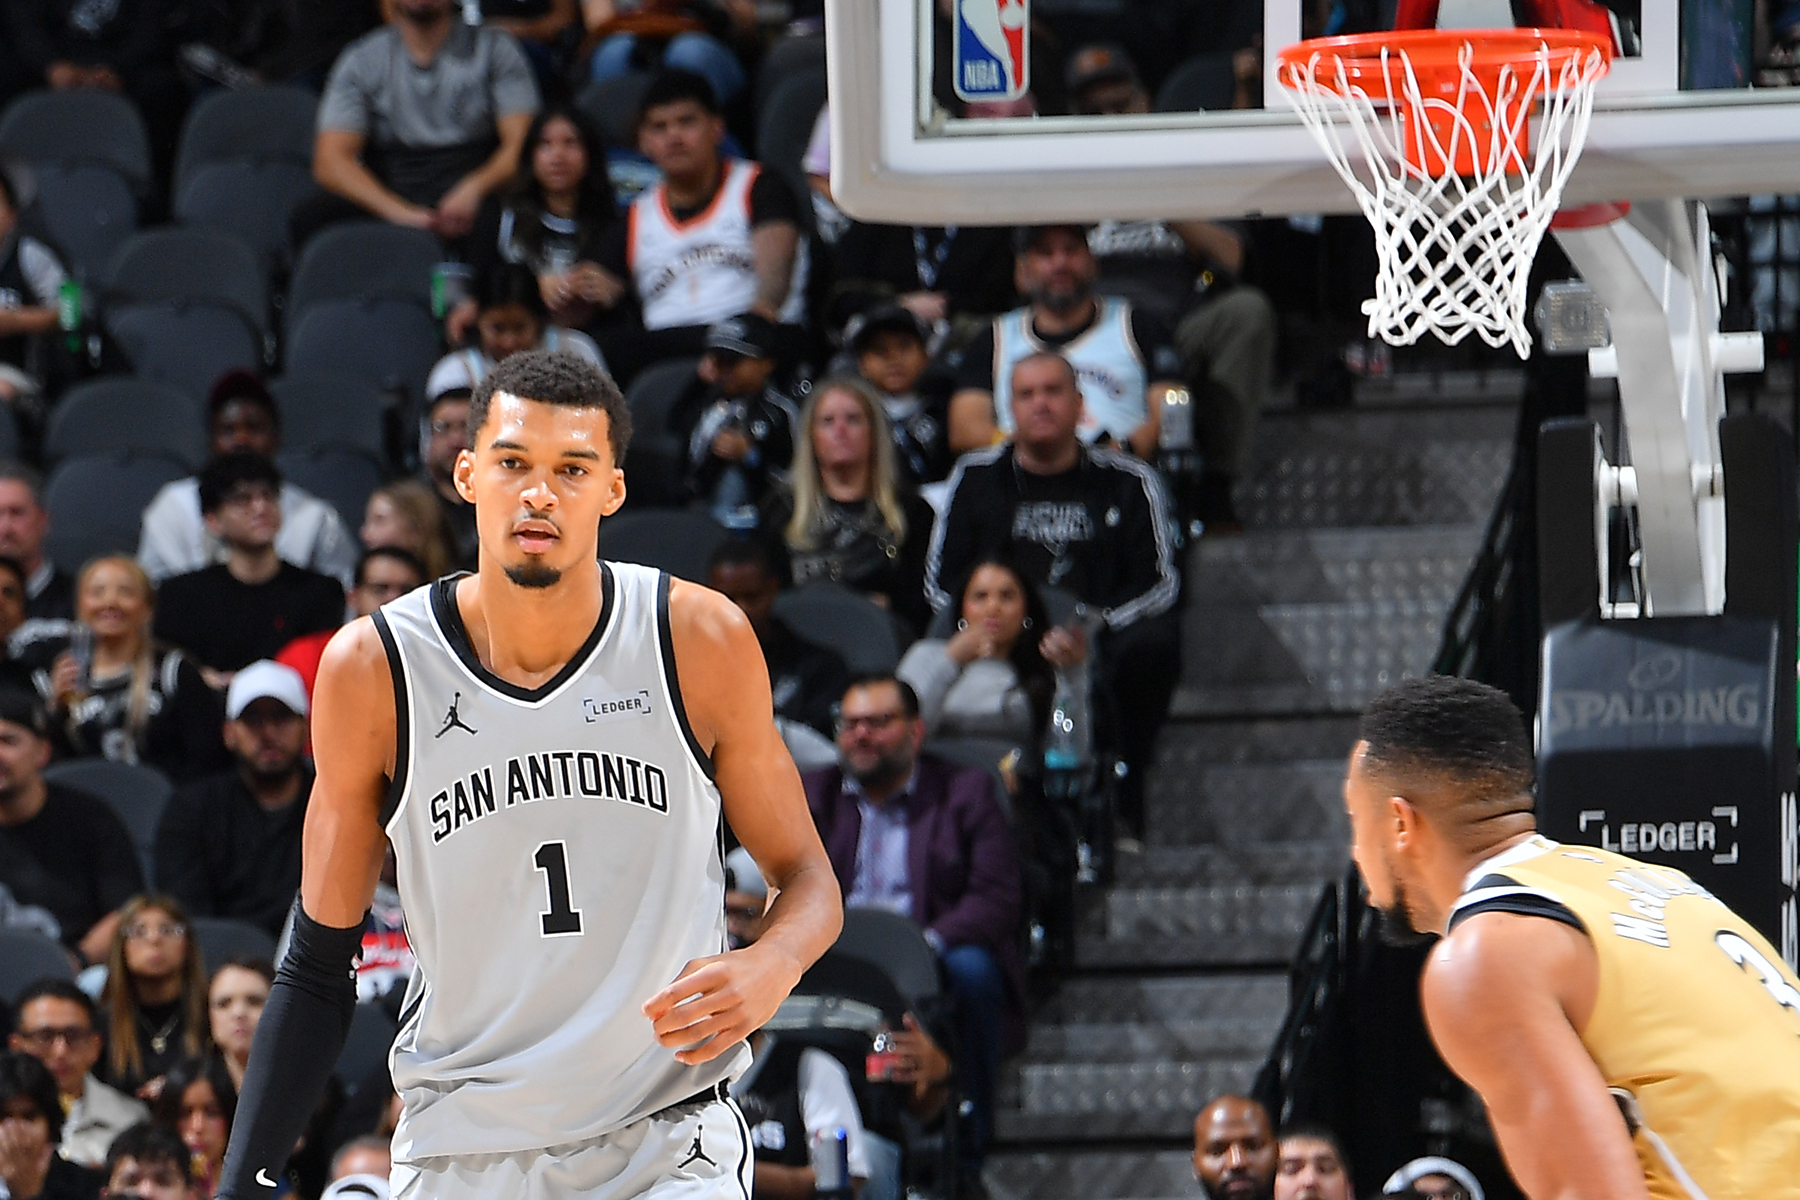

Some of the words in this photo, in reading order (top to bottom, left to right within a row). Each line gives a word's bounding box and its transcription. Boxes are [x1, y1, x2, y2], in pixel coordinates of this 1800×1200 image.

[964, 60, 1001, 91] NBA
[592, 698, 643, 716] LEDGER
[1551, 684, 1760, 736] SPALDING
[429, 765, 498, 845] SAN
[505, 750, 670, 816] ANTONIO
[1601, 820, 1717, 854] LEDGER
[532, 840, 585, 938] 1
